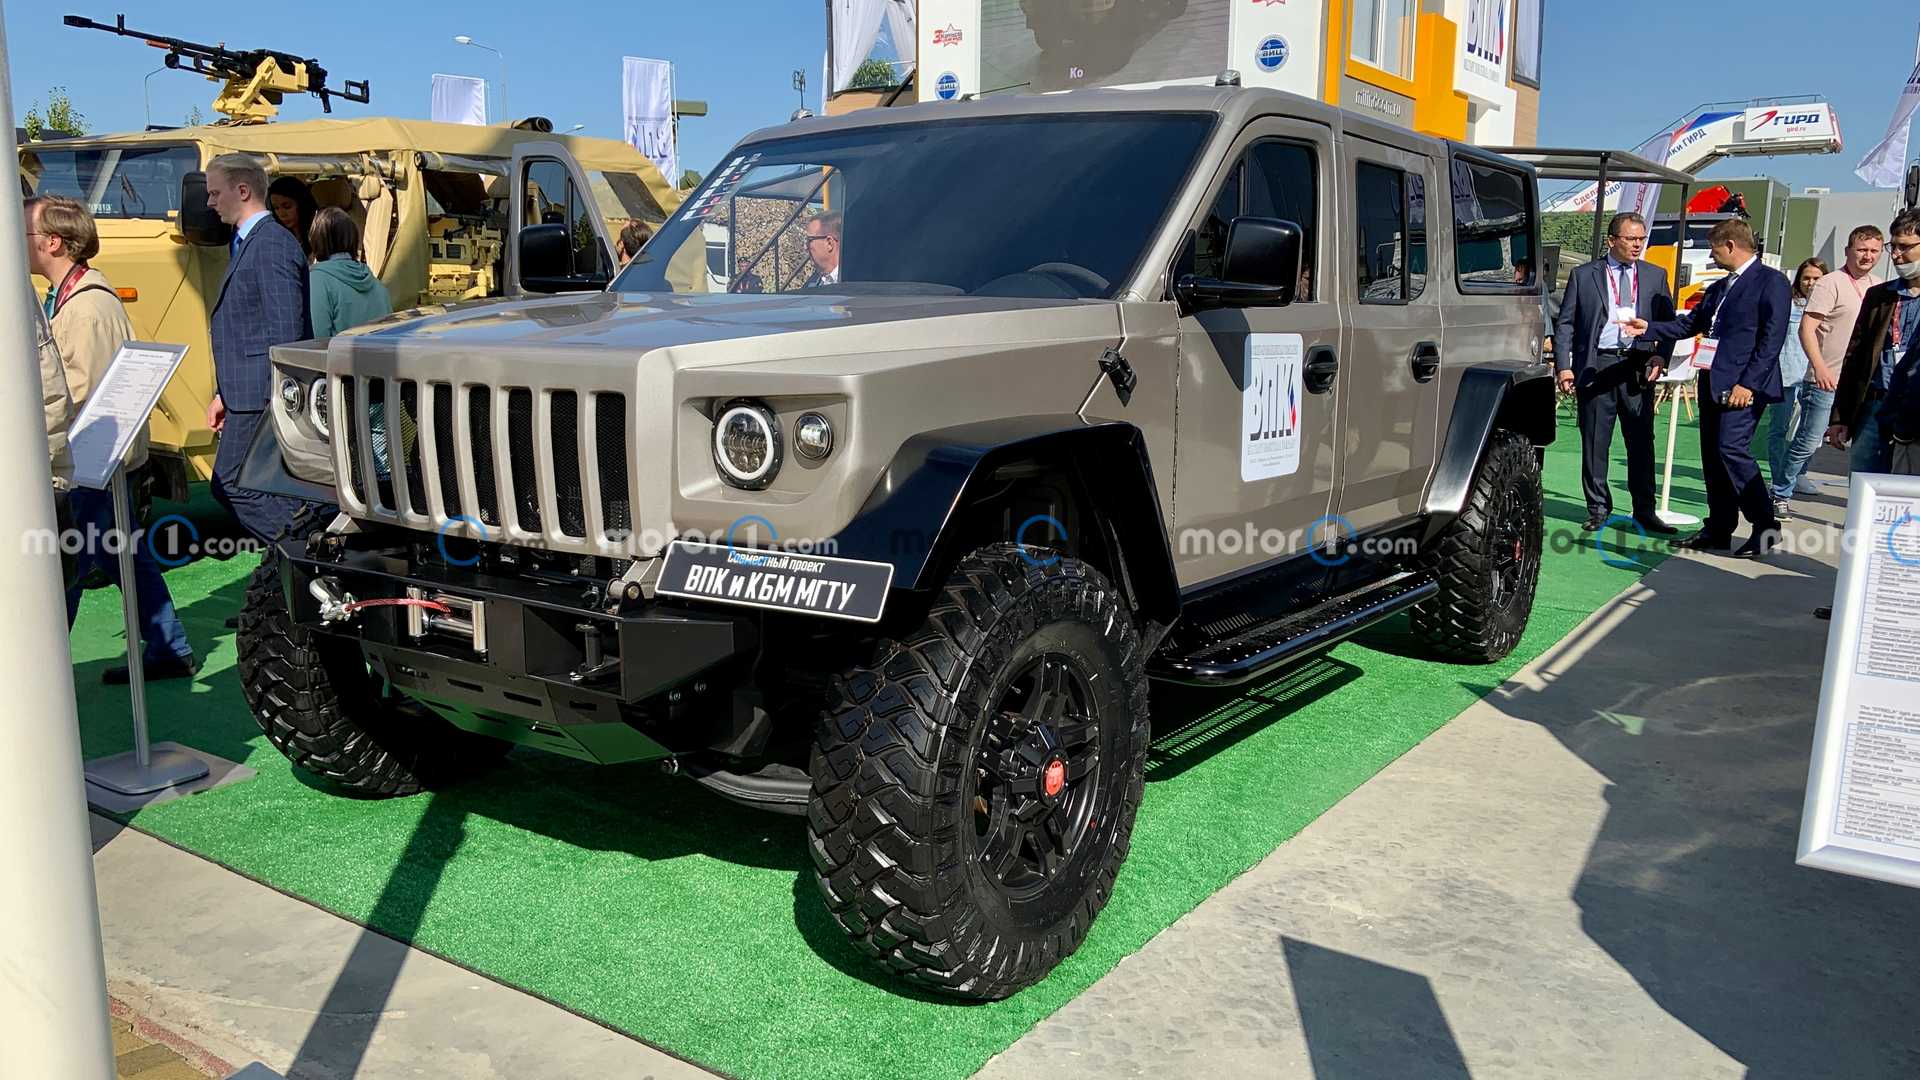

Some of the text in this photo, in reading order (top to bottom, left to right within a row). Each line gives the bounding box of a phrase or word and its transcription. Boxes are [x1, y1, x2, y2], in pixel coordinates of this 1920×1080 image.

[1682, 128, 1707, 148] ГИРД
[1249, 361, 1297, 442] ВПК
[727, 550, 826, 574] Совместный проект
[684, 563, 857, 611] ВПК и КБМ МГТУ
